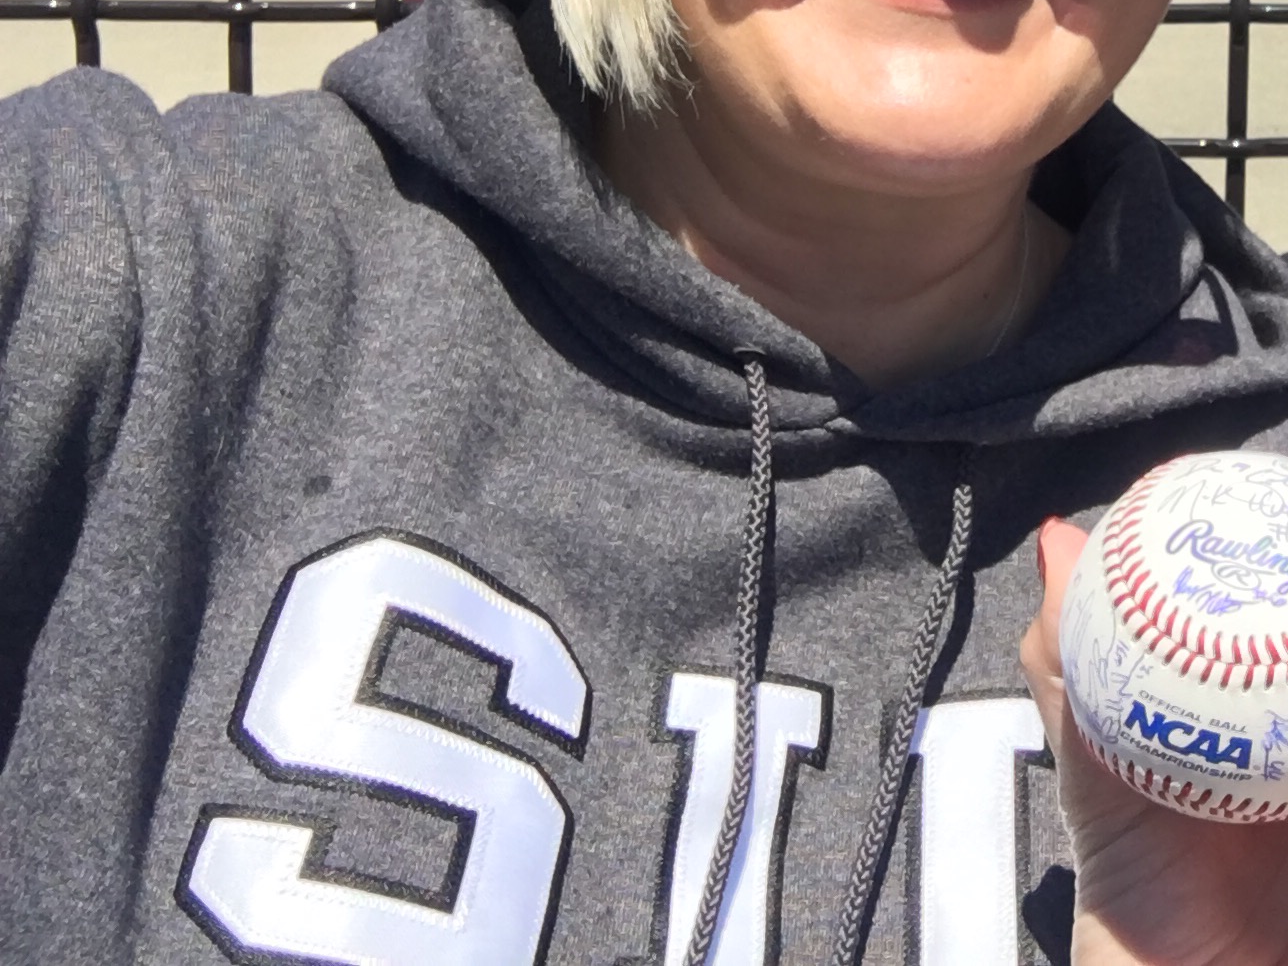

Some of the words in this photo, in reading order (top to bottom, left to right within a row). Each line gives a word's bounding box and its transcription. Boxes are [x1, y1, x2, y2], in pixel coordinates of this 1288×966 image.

[1124, 699, 1254, 771] NCAA
[1137, 689, 1202, 724] OFFICIAL
[1208, 718, 1249, 734] BALL
[1119, 730, 1254, 782] CHAMPIONSHIP
